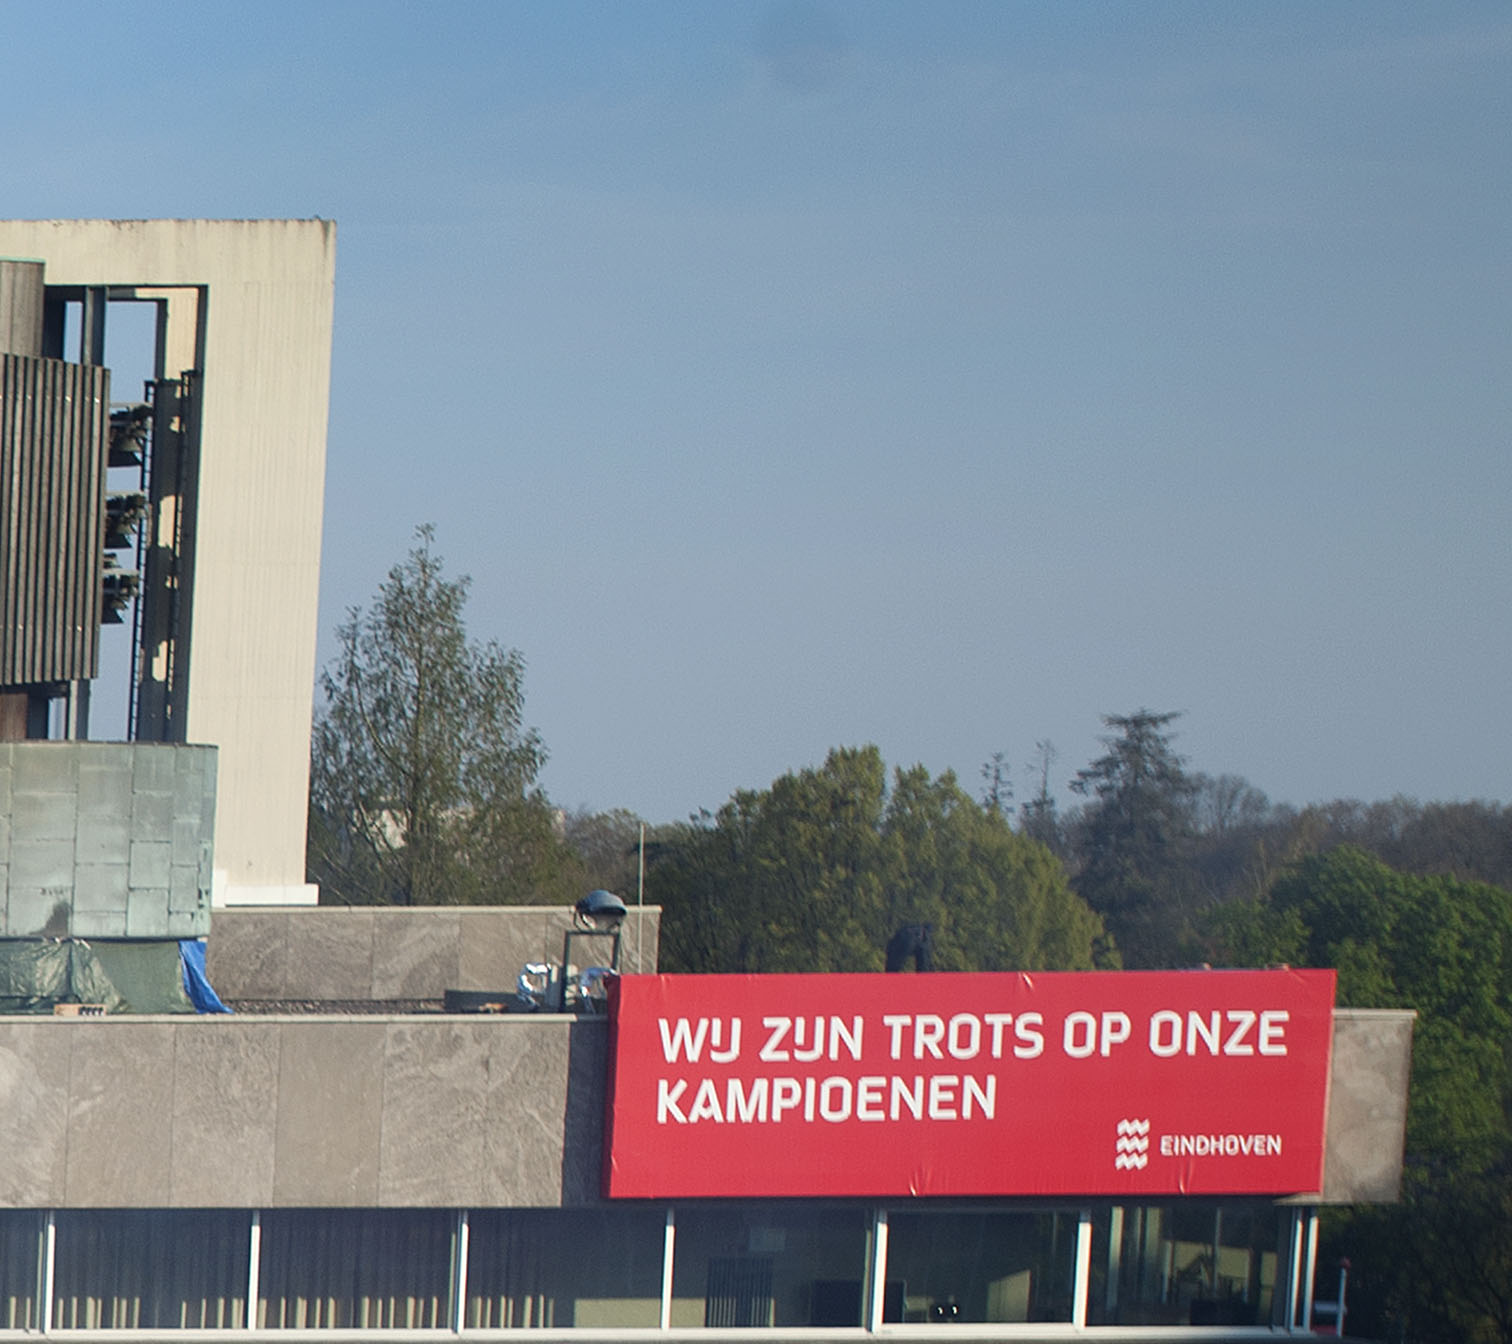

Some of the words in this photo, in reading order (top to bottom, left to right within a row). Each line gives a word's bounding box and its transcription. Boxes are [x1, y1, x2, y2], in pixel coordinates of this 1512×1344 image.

[884, 1013, 1045, 1060] TROTS
[1064, 1011, 1132, 1058] OP
[1148, 1010, 1290, 1057] ONZE
[656, 1074, 997, 1124] KAMPIOENEN
[1160, 1134, 1283, 1157] EINDHOVEN
